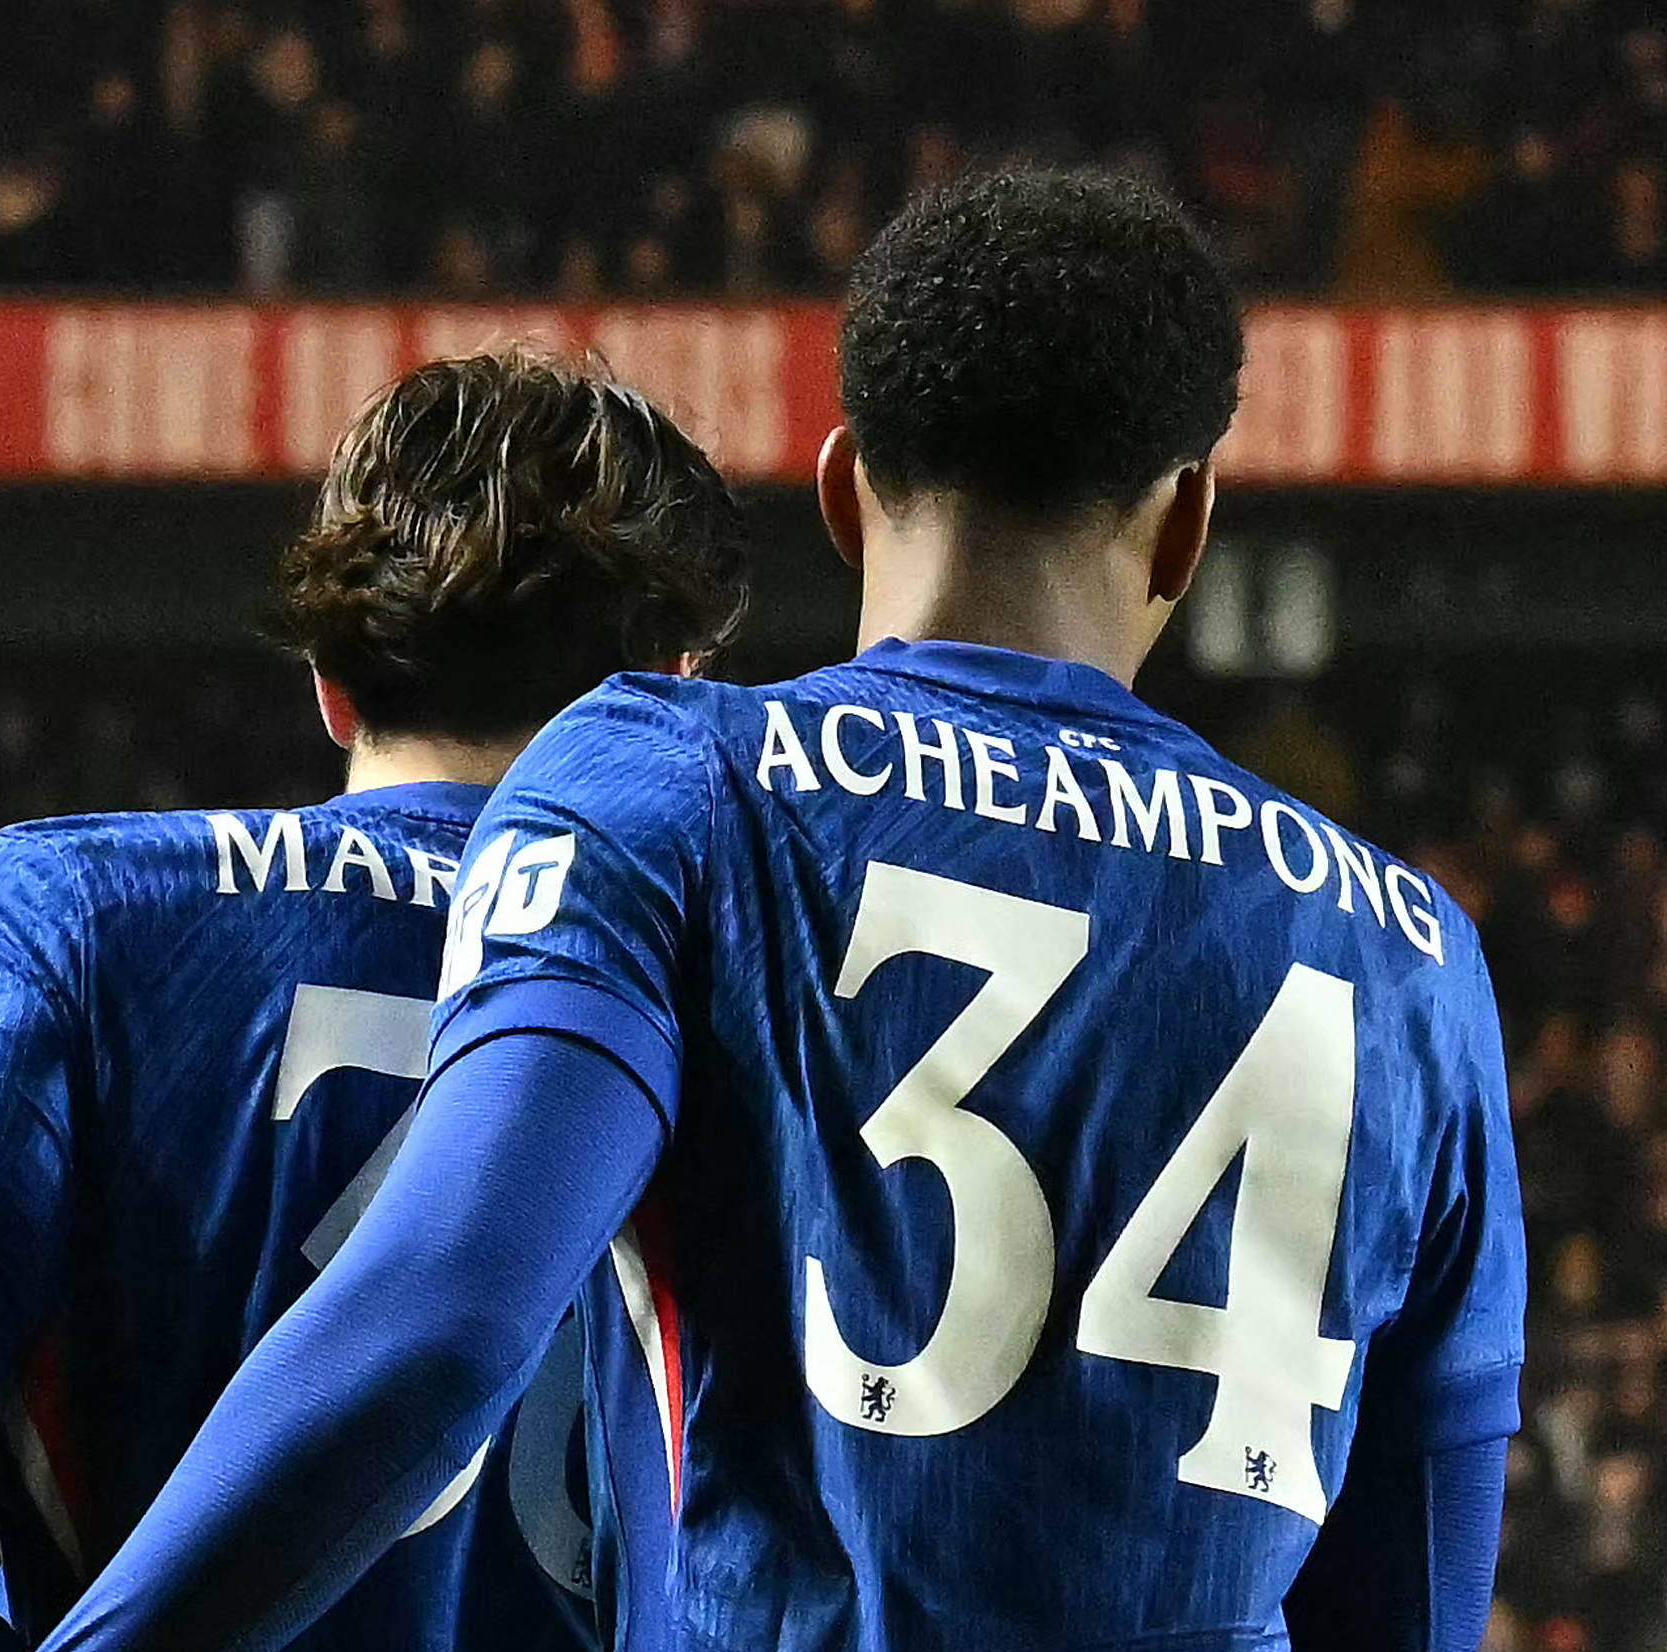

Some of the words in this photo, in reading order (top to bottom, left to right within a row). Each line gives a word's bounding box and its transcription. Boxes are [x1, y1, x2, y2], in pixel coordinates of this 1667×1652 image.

[1059, 729, 1122, 751] CFC
[206, 812, 461, 908] MAR
[756, 699, 1444, 966] ACHEAMPONG
[804, 860, 1356, 1527] 34
